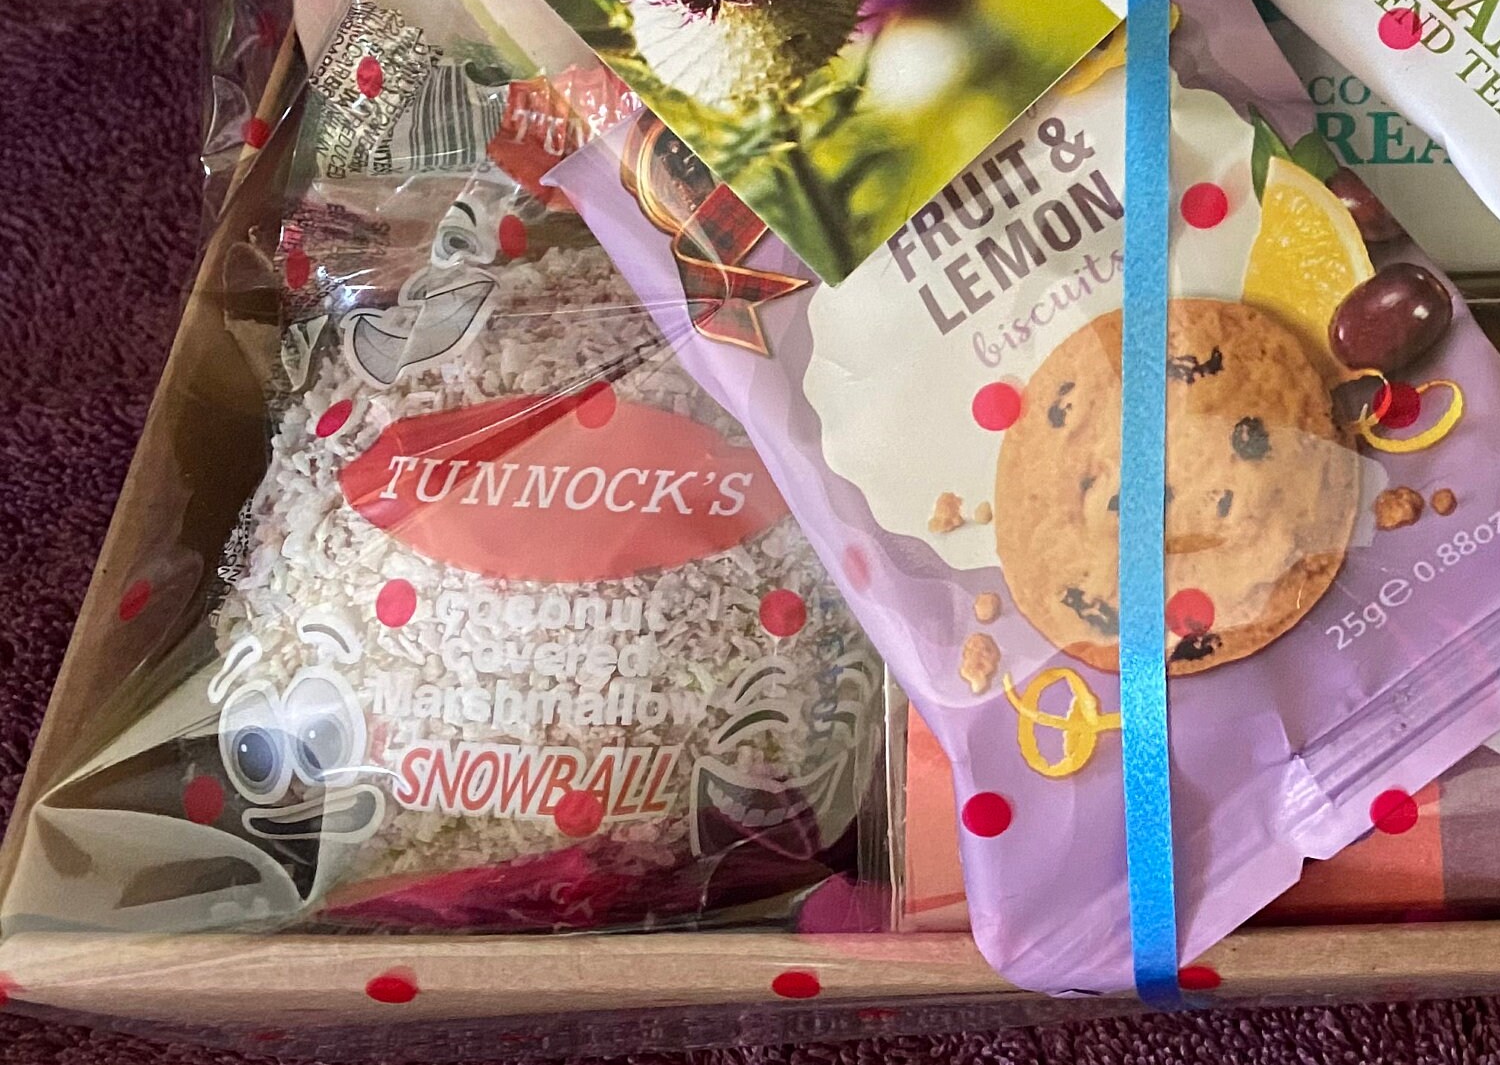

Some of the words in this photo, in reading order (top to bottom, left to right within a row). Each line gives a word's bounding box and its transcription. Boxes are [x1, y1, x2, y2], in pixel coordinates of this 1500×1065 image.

[887, 139, 1041, 283] FRUIT
[1037, 116, 1095, 174] &
[918, 169, 1124, 336] LEMON
[972, 248, 1125, 368] biscuits
[378, 455, 754, 518] TUNNOCK'S
[396, 744, 676, 817] SNOWBALL
